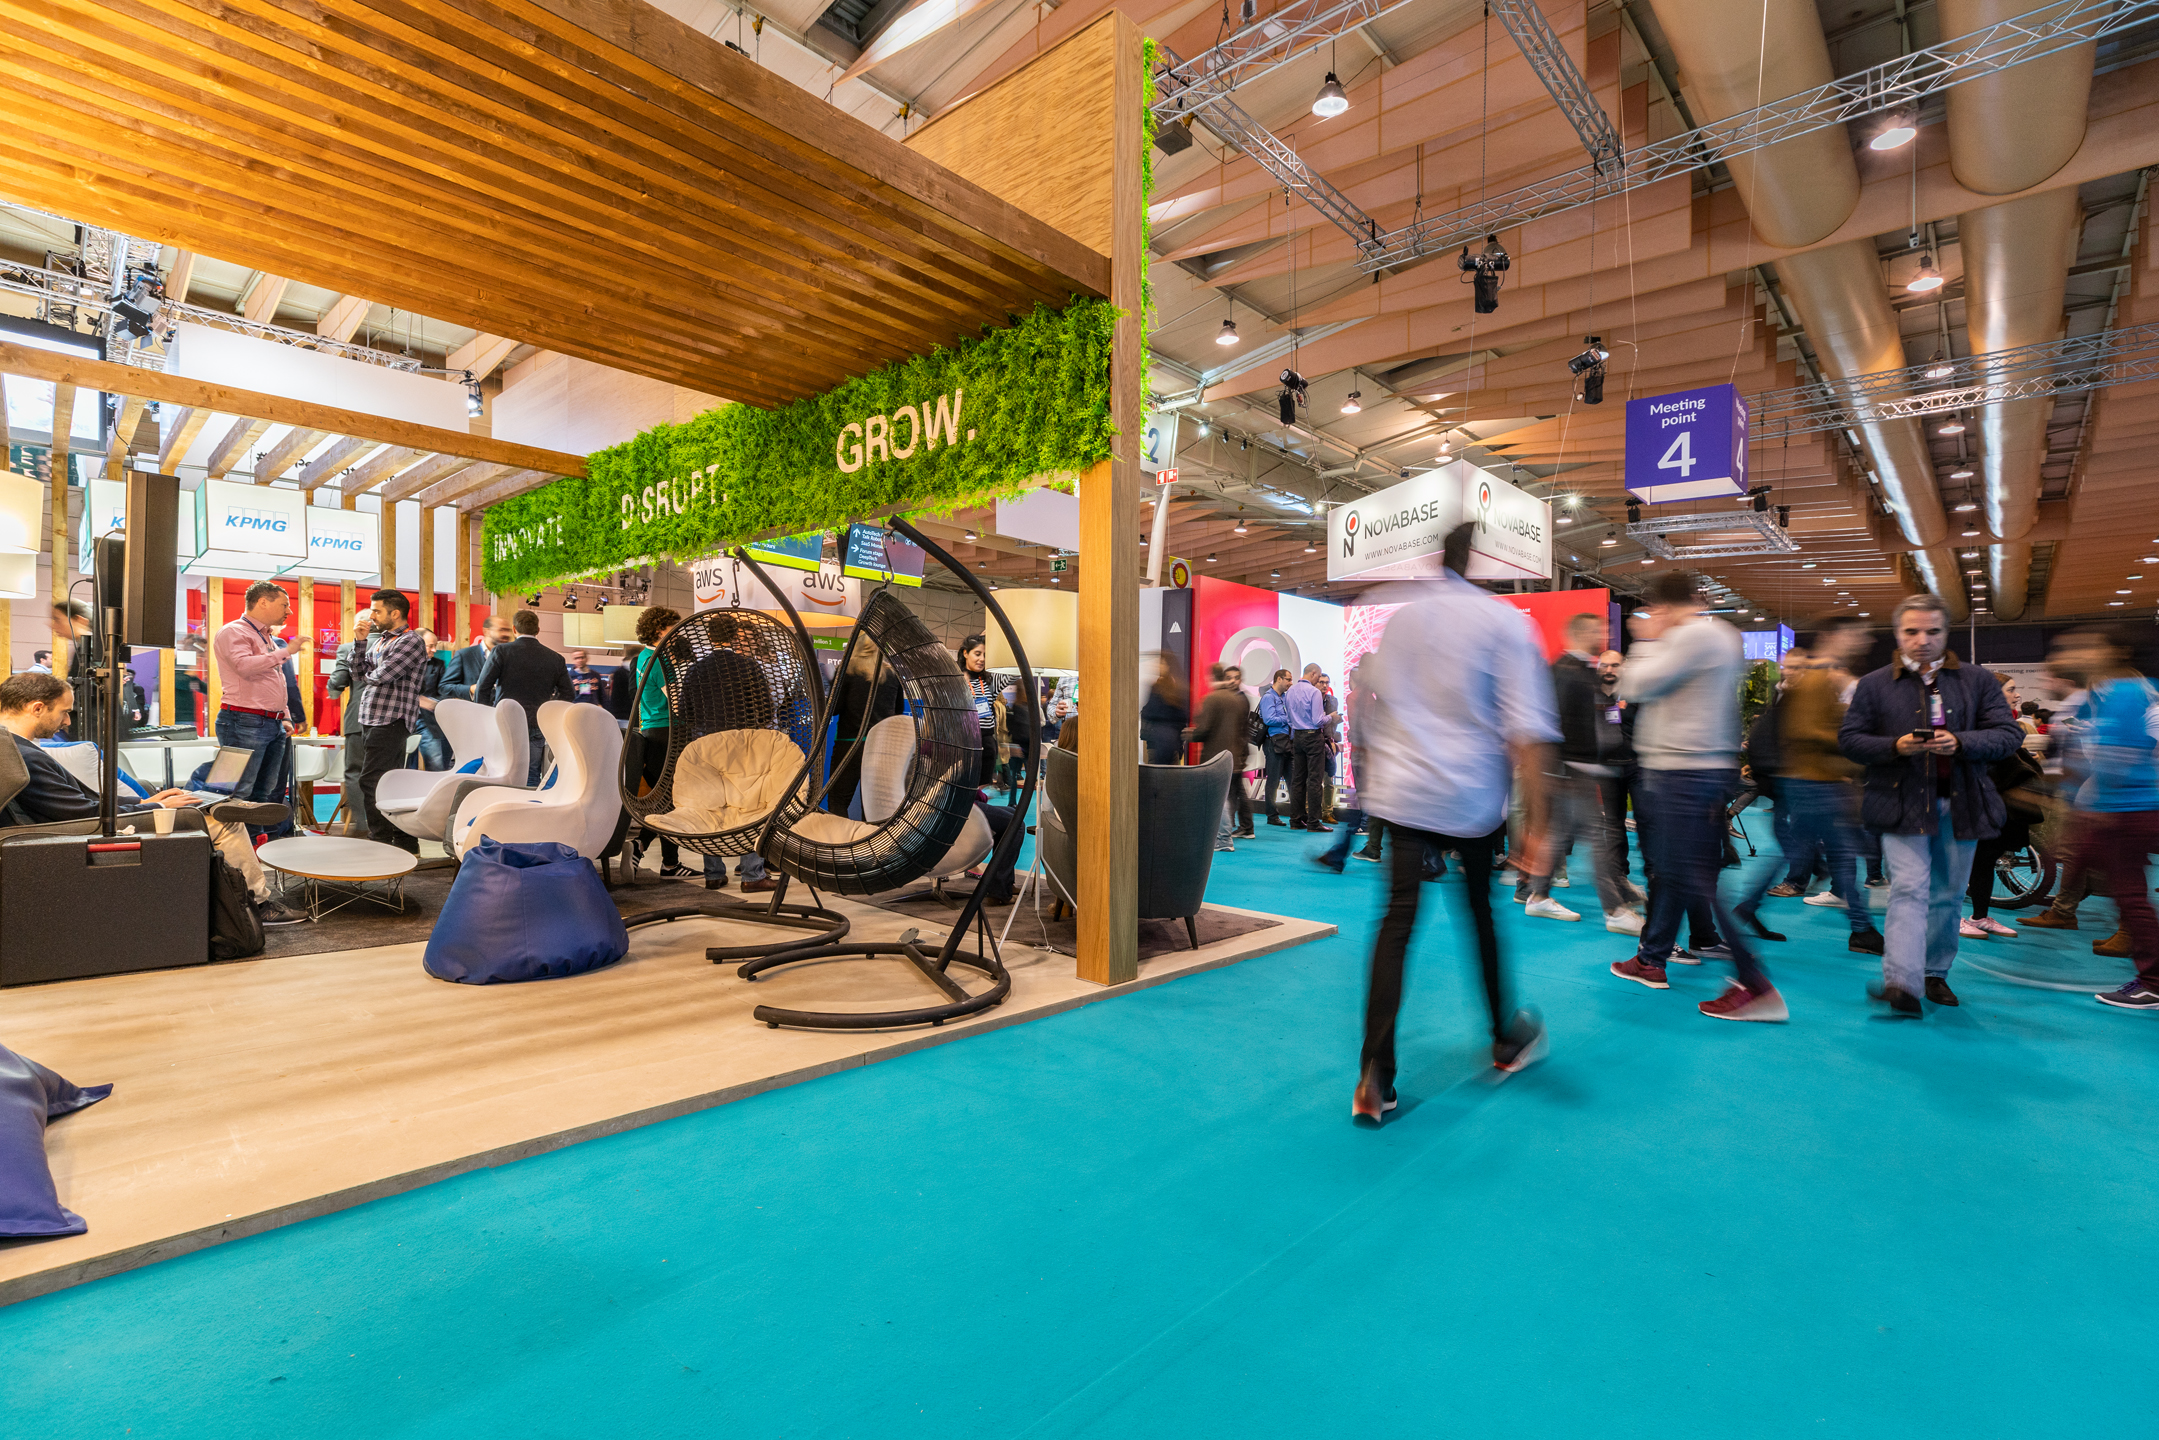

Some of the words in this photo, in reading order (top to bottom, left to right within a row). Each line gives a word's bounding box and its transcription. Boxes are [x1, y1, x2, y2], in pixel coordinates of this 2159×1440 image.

[1650, 398, 1706, 416] Meeting
[836, 388, 976, 474] GROW.
[1661, 412, 1697, 429] point
[1657, 431, 1697, 477] 4
[1736, 437, 1744, 482] 4
[621, 463, 728, 531] DISRUPT.
[225, 515, 288, 532] KPMG
[1364, 500, 1439, 540] NOVABASE
[1493, 507, 1542, 543] NOVABASE
[310, 536, 363, 551] KPMG
[1364, 533, 1439, 561] WWW.NOVABASE.COM
[1494, 540, 1542, 565] WWW.NOVABASE.COM
[696, 568, 723, 590] aws
[803, 571, 845, 593] aws
